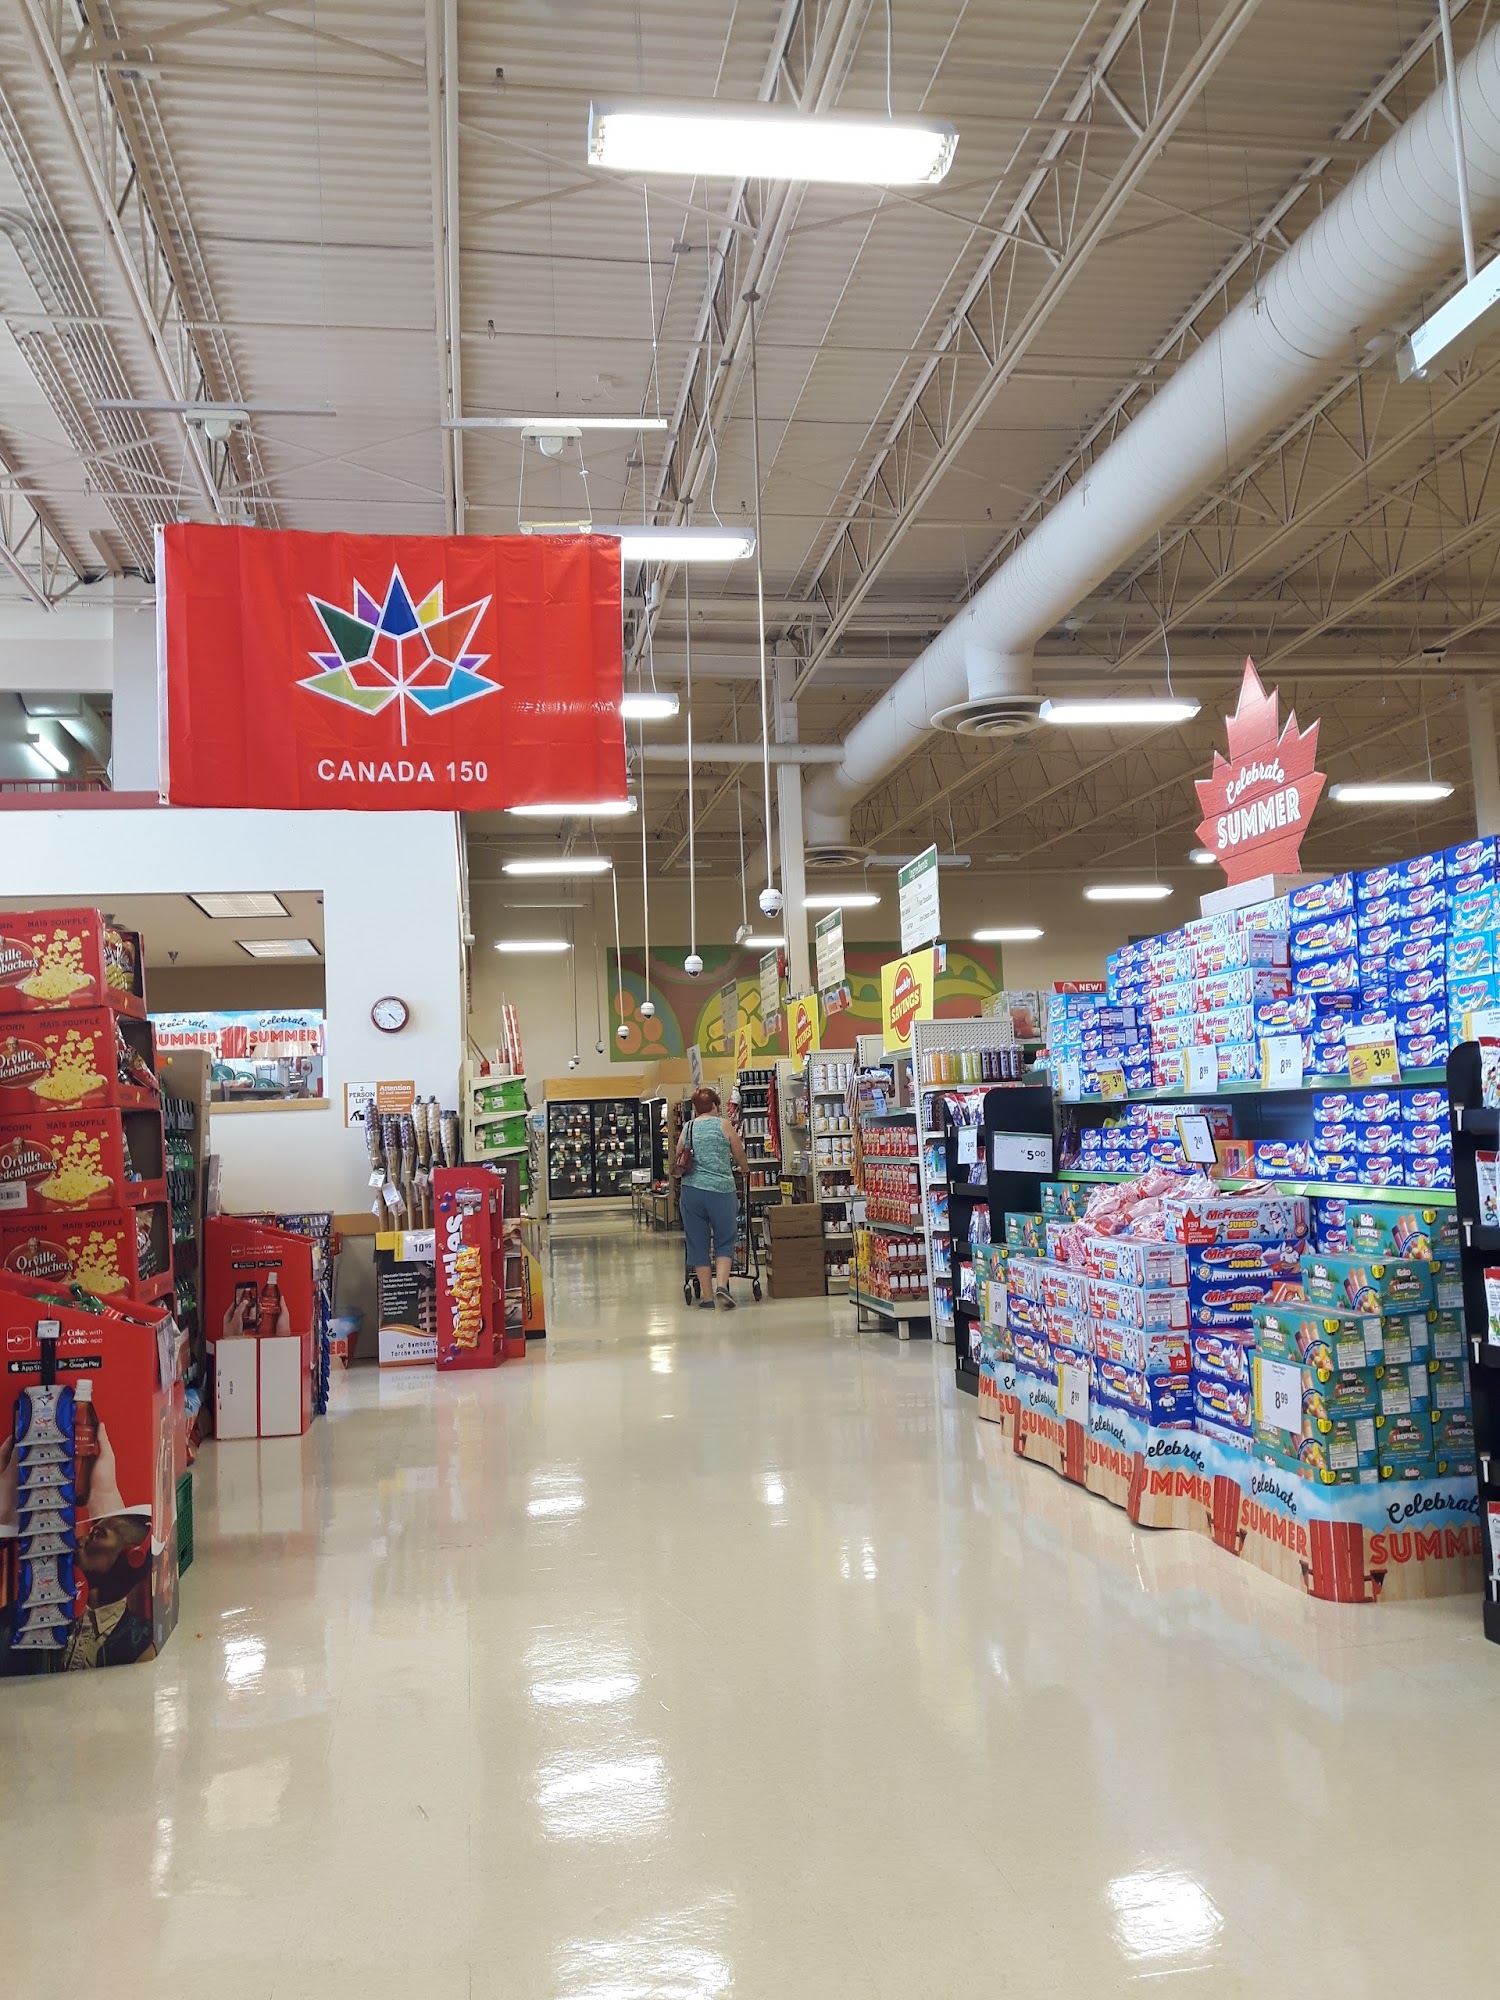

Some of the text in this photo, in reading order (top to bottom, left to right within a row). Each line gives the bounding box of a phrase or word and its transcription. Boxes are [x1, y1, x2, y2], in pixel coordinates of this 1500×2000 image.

[317, 758, 488, 782] CANADA 150
[1226, 758, 1285, 804] Celebrate
[1217, 787, 1301, 849] SUMMER
[0, 948, 22, 964] ville
[1079, 982, 1102, 993] NEW!
[891, 989, 920, 1022] SAVINGS
[260, 1015, 308, 1028] Celebrate
[155, 1031, 218, 1047] UMMER
[250, 1029, 317, 1044] SUMMER
[0, 1059, 51, 1079] enbacher's
[1, 1149, 41, 1169] Orville
[1227, 1220, 1258, 1229] JUMBO
[16, 1250, 57, 1270] Orville
[1228, 1259, 1261, 1269] JUMBO
[1393, 1282, 1420, 1290] TROPICS
[408, 1340, 430, 1348] Bamboo
[68, 1361, 88, 1370] Google
[88, 1360, 100, 1368] Play
[1338, 1386, 1365, 1395] TROPICS
[1393, 1431, 1420, 1441] TROPICS
[1146, 1440, 1205, 1472] elebrate
[1141, 1469, 1212, 1509] UMMER
[1251, 1474, 1298, 1515] Celebrate
[1387, 1492, 1480, 1524] Celebrat
[1241, 1498, 1308, 1557] SUMMER
[1369, 1526, 1483, 1565] SUMME
